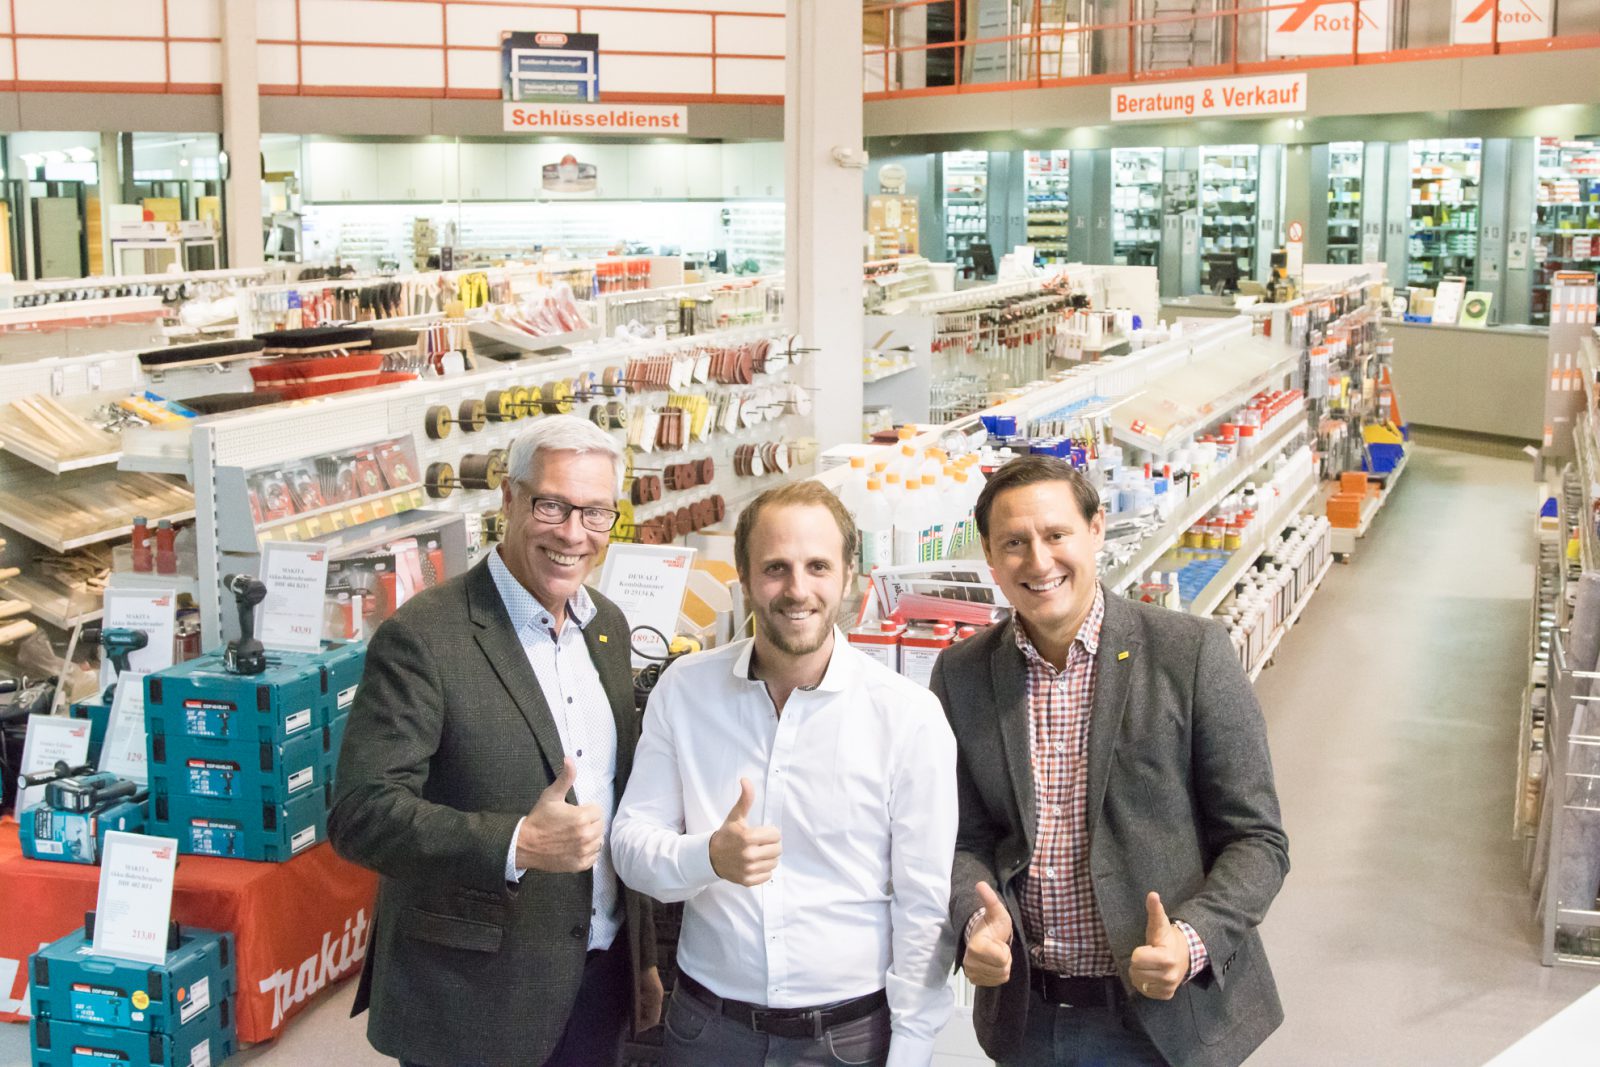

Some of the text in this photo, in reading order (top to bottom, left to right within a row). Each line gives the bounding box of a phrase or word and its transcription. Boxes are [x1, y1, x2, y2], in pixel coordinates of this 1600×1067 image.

[1116, 82, 1300, 114] Beratung & Verkauf
[511, 108, 681, 128] Schlüsseldienst
[258, 907, 371, 1031] Makit
